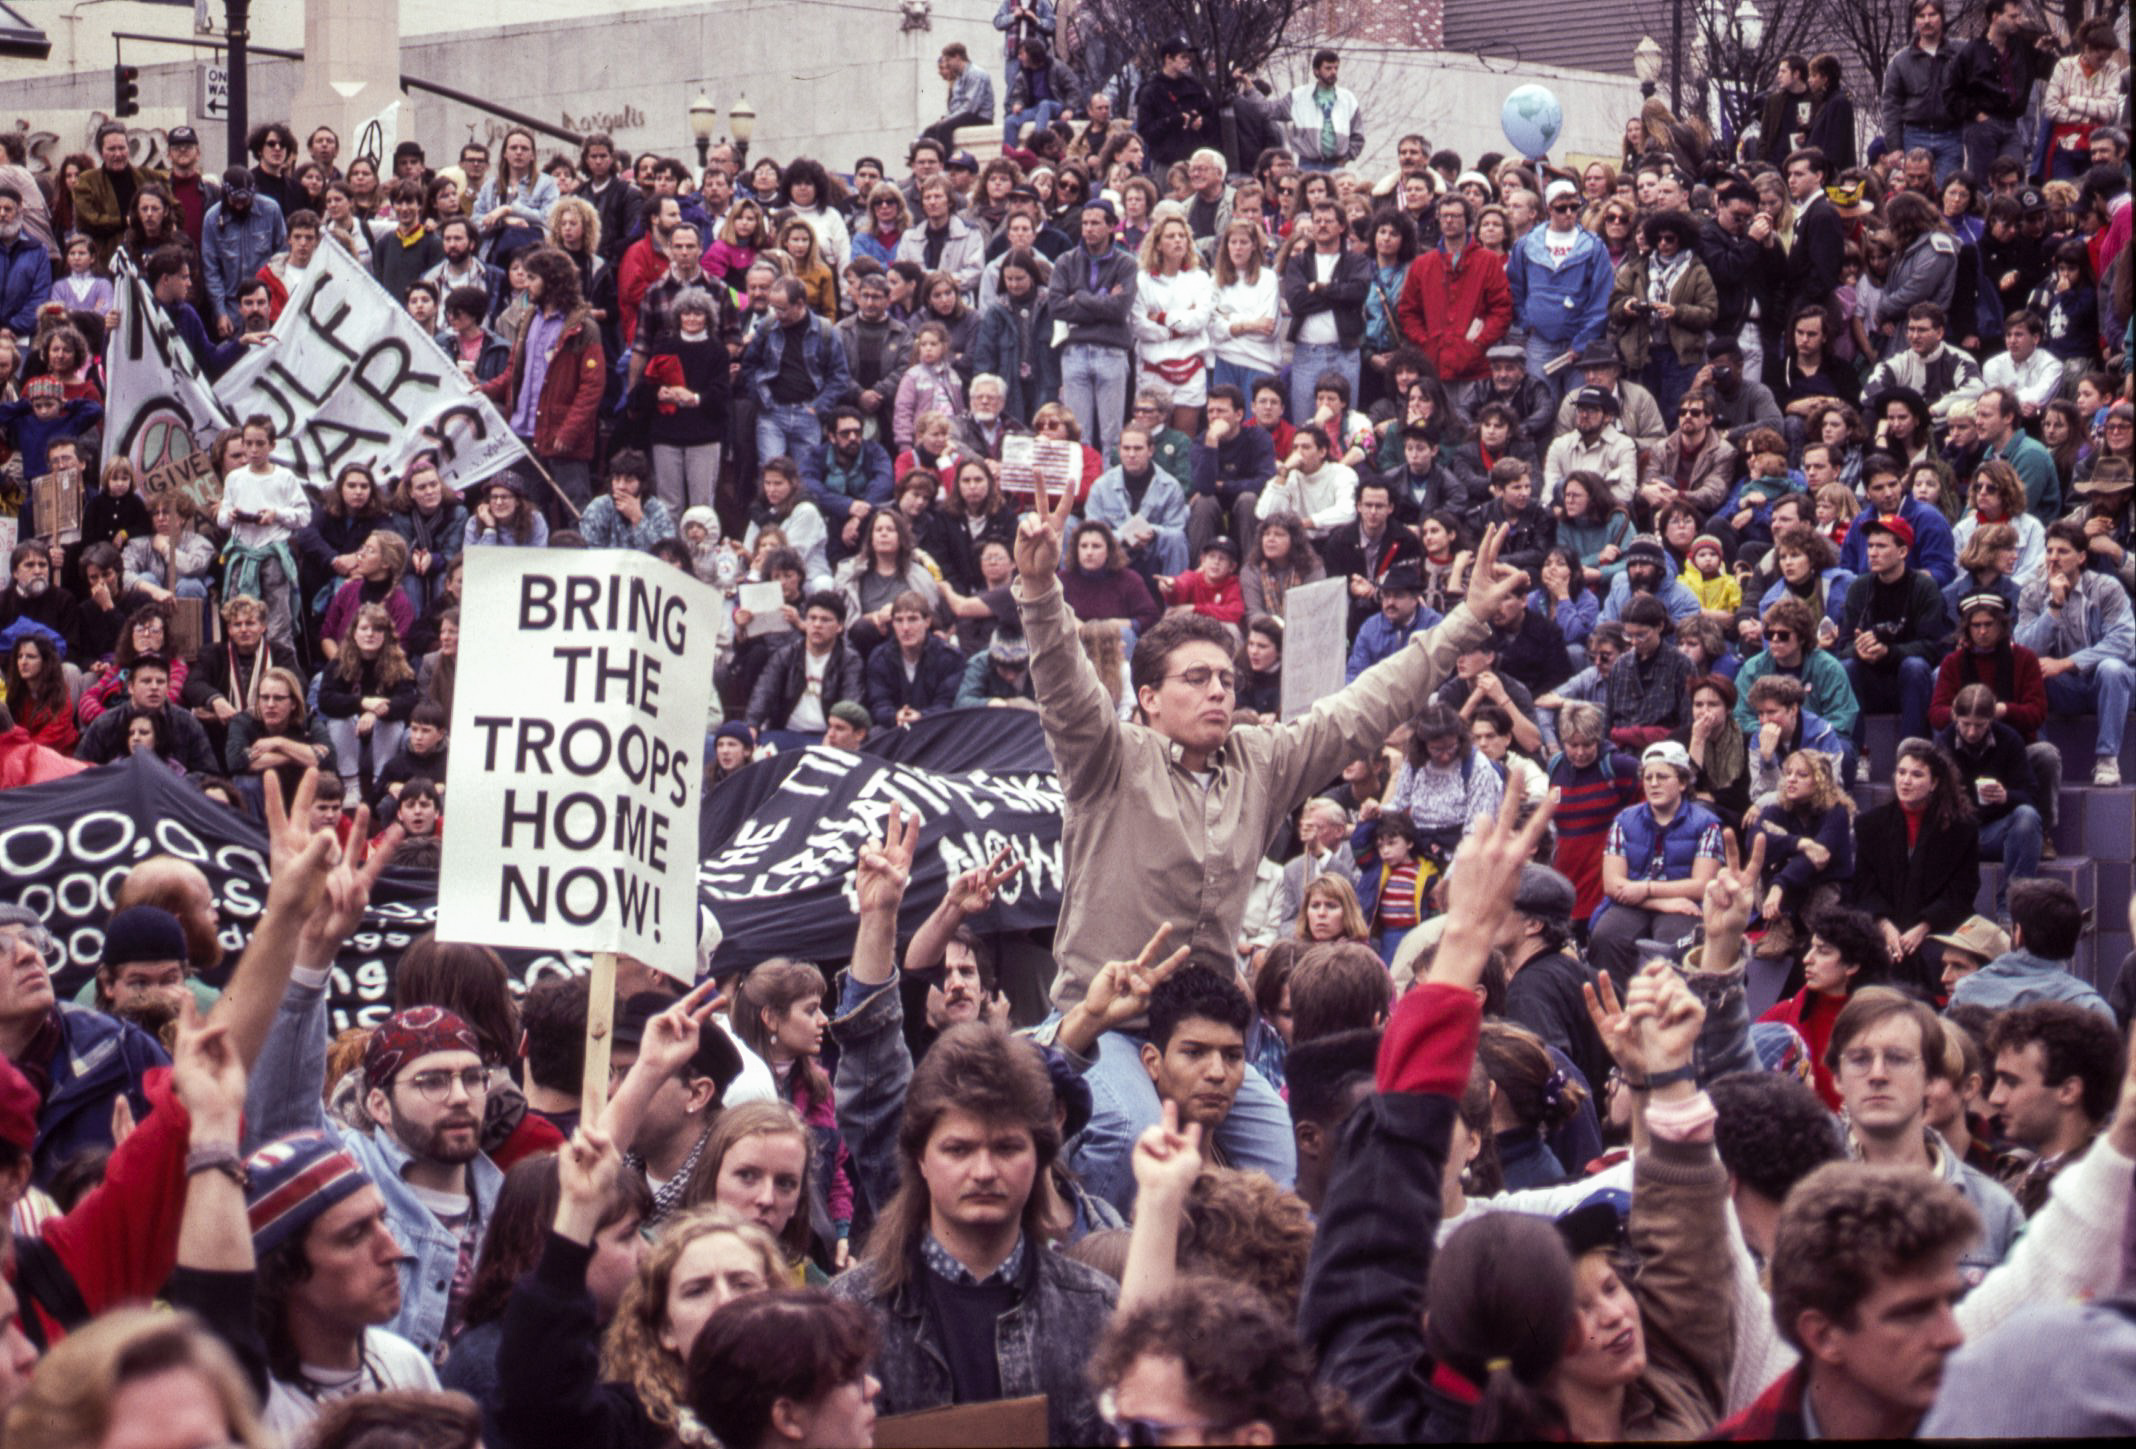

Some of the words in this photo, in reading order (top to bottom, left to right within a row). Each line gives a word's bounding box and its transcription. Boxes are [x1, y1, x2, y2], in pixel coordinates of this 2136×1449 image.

[208, 70, 228, 82] ON
[208, 84, 228, 96] WA
[213, 271, 360, 440] ULF
[148, 452, 210, 493] GIVE
[518, 573, 688, 656] BRING
[553, 645, 661, 719] THE
[473, 715, 689, 808] TROOPS
[501, 788, 670, 874] HOME
[498, 863, 662, 944] NOW!
